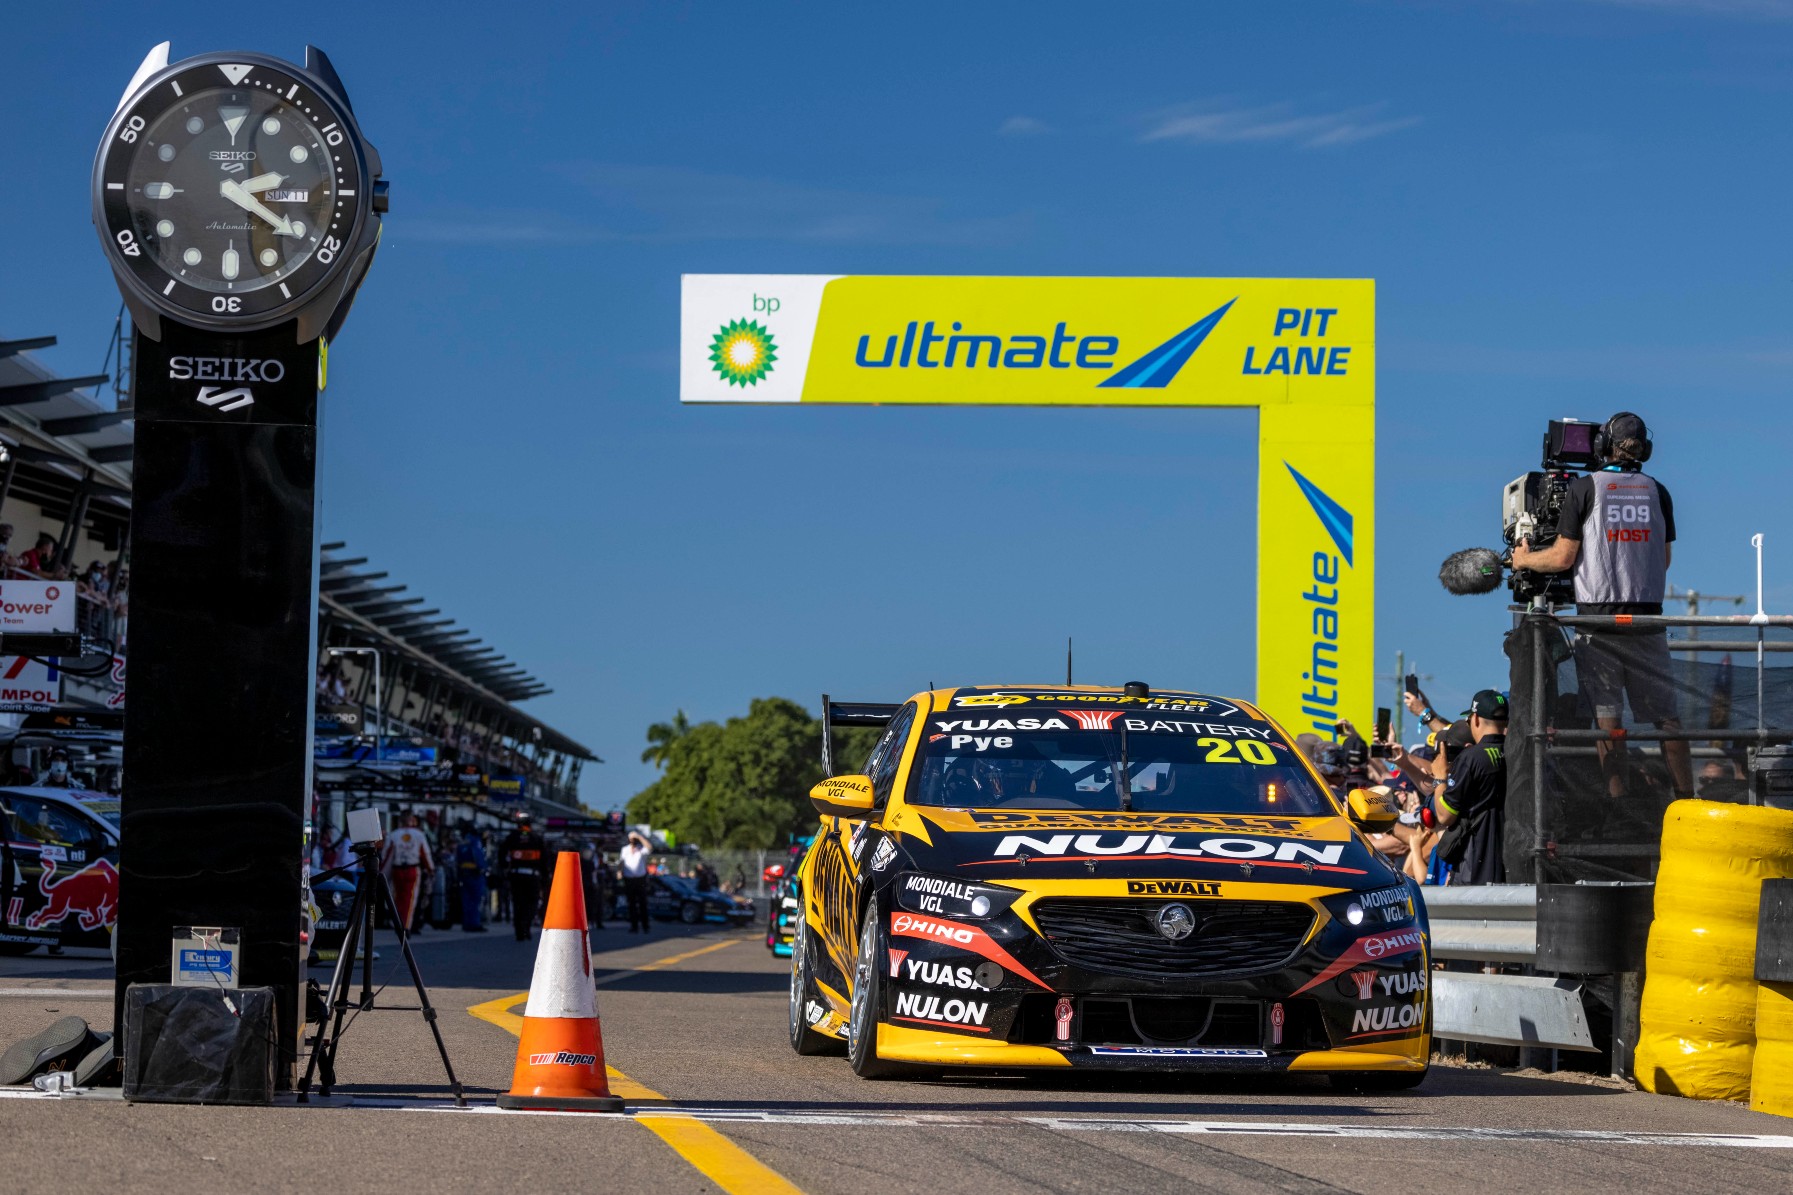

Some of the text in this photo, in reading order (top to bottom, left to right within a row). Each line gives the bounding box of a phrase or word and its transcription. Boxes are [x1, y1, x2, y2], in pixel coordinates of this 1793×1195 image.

[120, 115, 146, 144] 50
[322, 122, 344, 146] 10
[208, 151, 257, 161] SEIKO
[267, 190, 305, 200] SUN 11
[117, 229, 141, 257] 40
[317, 235, 341, 264] 20
[211, 296, 242, 312] 30
[752, 294, 781, 316] bp
[1273, 308, 1337, 338] PIT
[855, 320, 1119, 369] ultimate
[169, 356, 285, 383] SEIKO
[1241, 346, 1351, 376] LANE
[1607, 504, 1651, 523] 509
[1607, 528, 1652, 542] HOST
[2, 689, 56, 703] MPOL
[1146, 703, 1210, 713] FLEET
[934, 718, 1273, 740] YUASA BATTERY
[951, 734, 1013, 752] Pye
[1196, 737, 1278, 766] 20
[817, 780, 870, 793] MONDIALE
[828, 788, 846, 798] VGL
[971, 813, 1302, 830] DEWALT
[994, 834, 1345, 865] NULON
[906, 876, 975, 900] MONDIALE
[1127, 880, 1223, 897] DEWALT
[1360, 888, 1408, 910] MONDIALE
[920, 895, 944, 913] VGL
[1383, 907, 1403, 923] VGL
[911, 920, 975, 944] HINO
[1380, 970, 1426, 996] YUAS
[896, 992, 988, 1025] NULON
[1352, 1002, 1424, 1033] NULON
[554, 1052, 596, 1066] Repco
